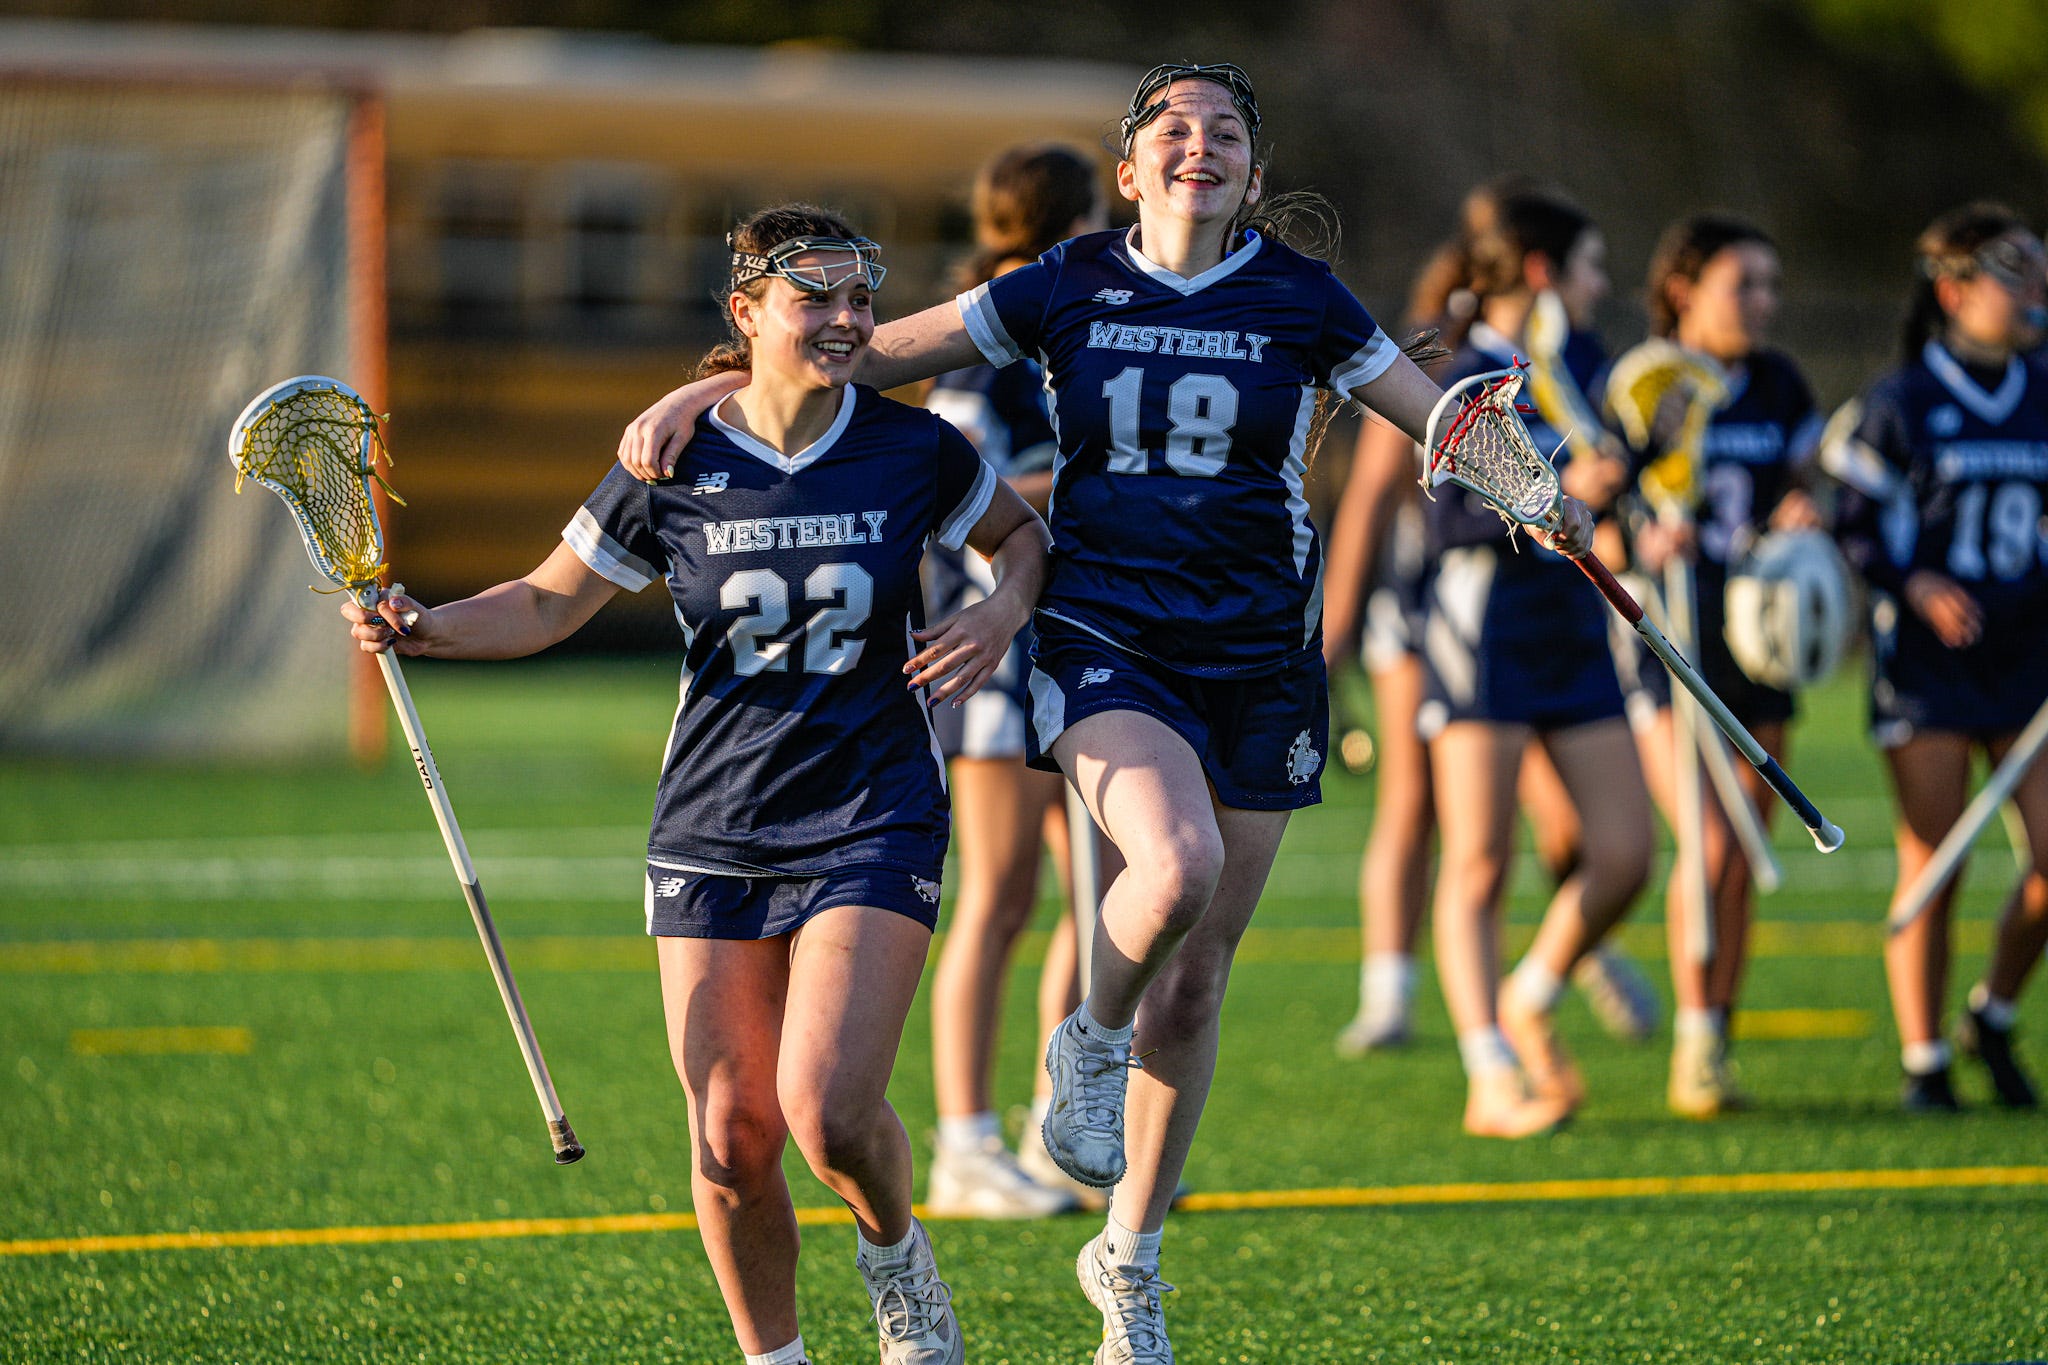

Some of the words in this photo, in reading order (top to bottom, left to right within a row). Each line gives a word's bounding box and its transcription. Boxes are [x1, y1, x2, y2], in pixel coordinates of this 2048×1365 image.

[1087, 321, 1271, 362] WESTERLY
[1102, 367, 1239, 477] 18
[703, 511, 887, 555] WESTERLY
[719, 562, 874, 677] 22
